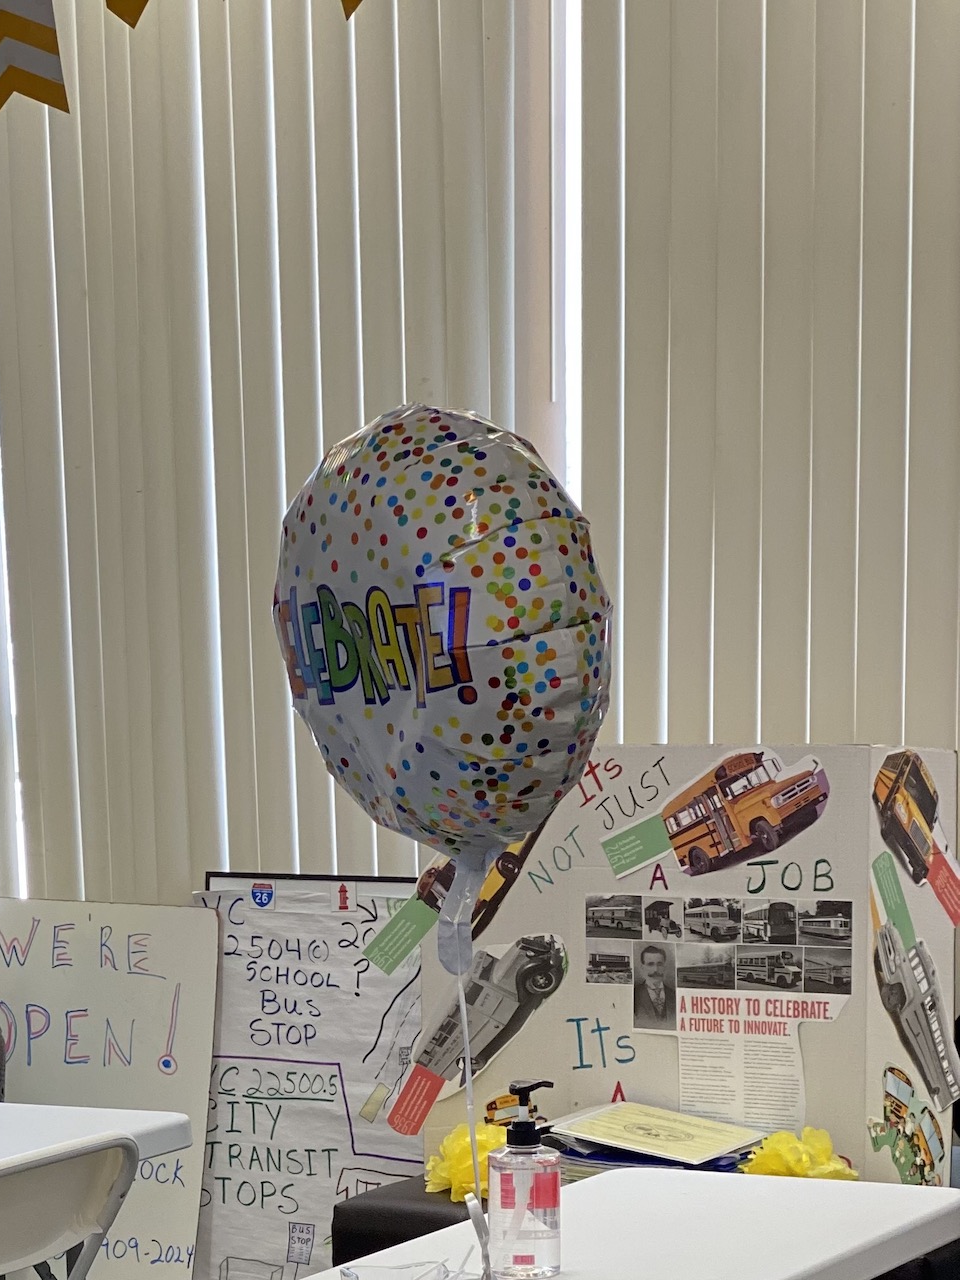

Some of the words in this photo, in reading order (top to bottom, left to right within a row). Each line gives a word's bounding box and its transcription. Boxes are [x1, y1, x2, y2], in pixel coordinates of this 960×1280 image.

[275, 582, 478, 709] ELEBRATE!
[528, 825, 585, 893] NOT
[595, 756, 670, 831] JUST
[649, 863, 669, 890] A
[746, 858, 834, 894] JOB
[255, 892, 269, 904] 26
[246, 961, 340, 988] SCHOOL
[680, 995, 687, 1013] A
[691, 996, 741, 1016] HISTORY
[745, 998, 760, 1016] TO
[765, 999, 834, 1020] CELEBRATE.
[249, 1018, 317, 1046] STOP
[680, 1017, 686, 1031] A
[689, 1018, 724, 1033] FUTURE
[728, 1019, 740, 1034] TO
[743, 1020, 791, 1036] INNOVATE.
[566, 1017, 636, 1071] Its
[245, 1068, 338, 1097] 22500.5
[136, 1158, 186, 1188] OCK
[205, 1141, 339, 1179] TRANSIT
[290, 1235, 312, 1246] STOP
[291, 1224, 312, 1235] BUS
